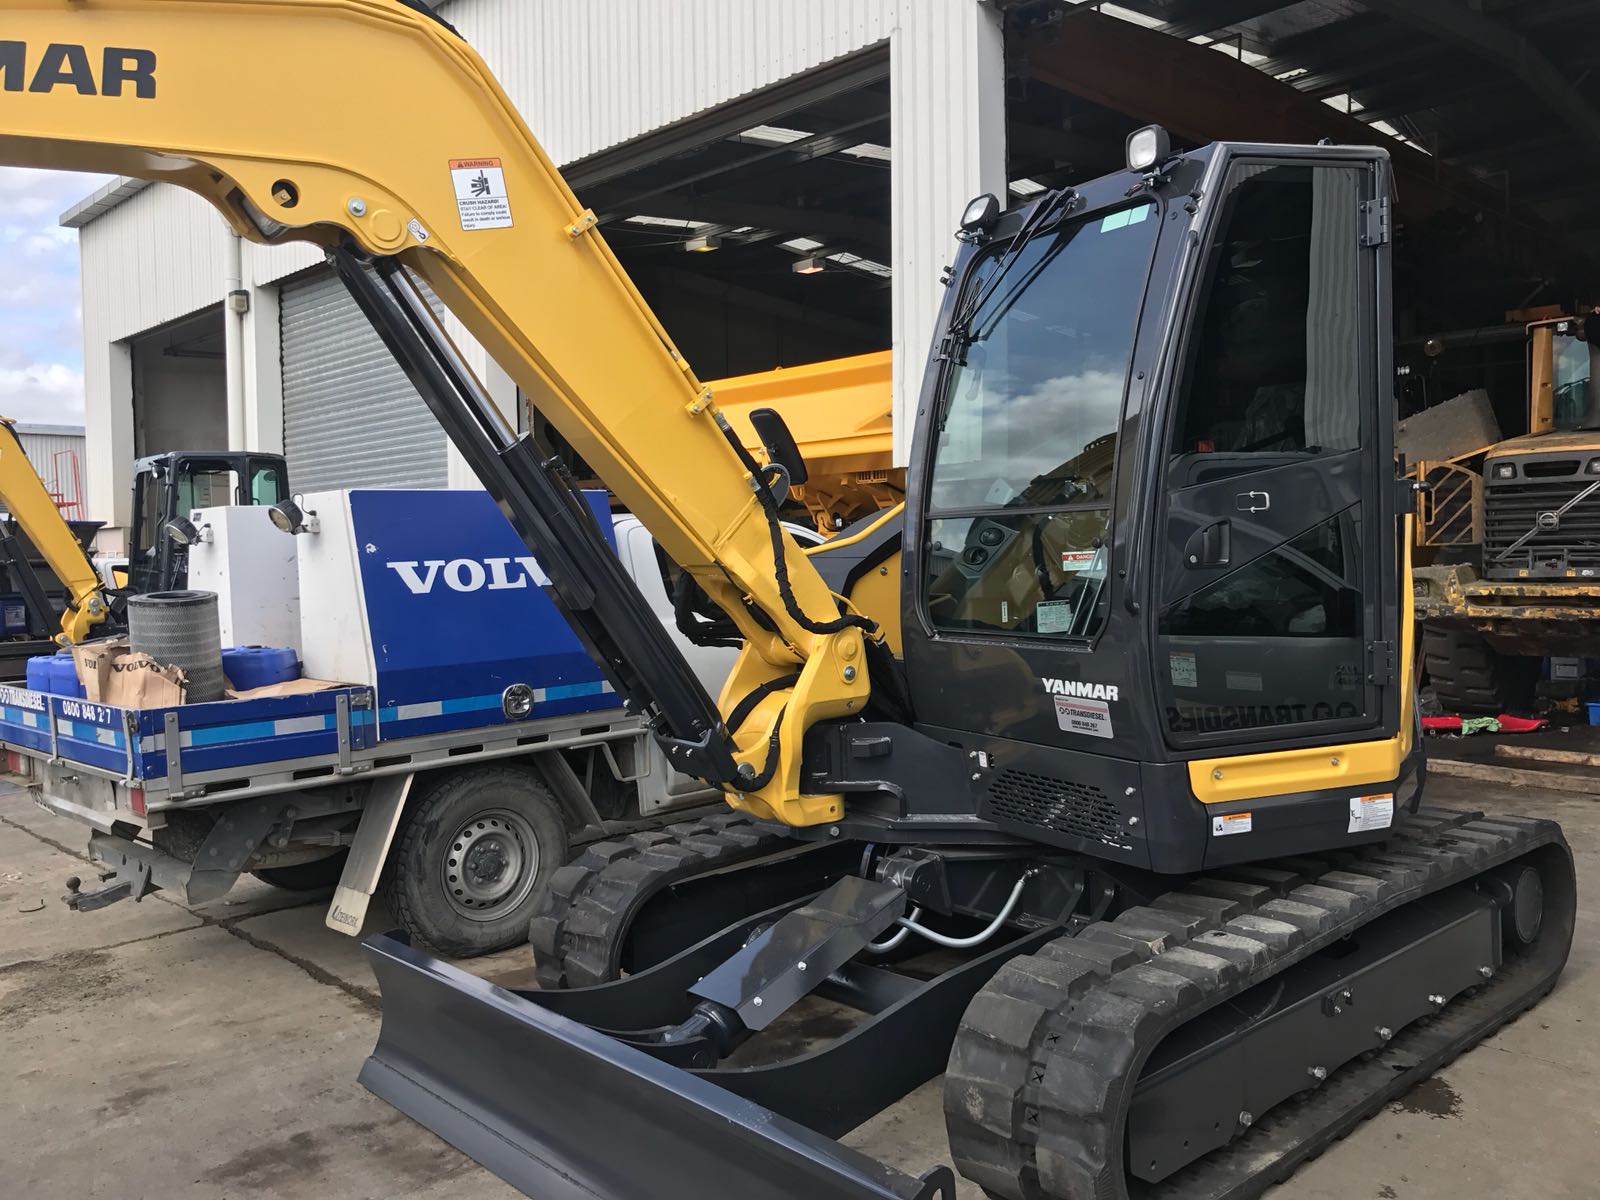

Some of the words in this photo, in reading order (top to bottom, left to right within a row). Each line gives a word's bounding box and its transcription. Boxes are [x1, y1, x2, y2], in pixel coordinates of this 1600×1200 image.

[111, 660, 161, 673] VOLVO
[1041, 678, 1119, 701] YANMAR
[62, 700, 80, 718] 0800
[82, 704, 96, 721] 848
[98, 706, 111, 724] 27
[1070, 709, 1104, 720] TRANSDIESEL
